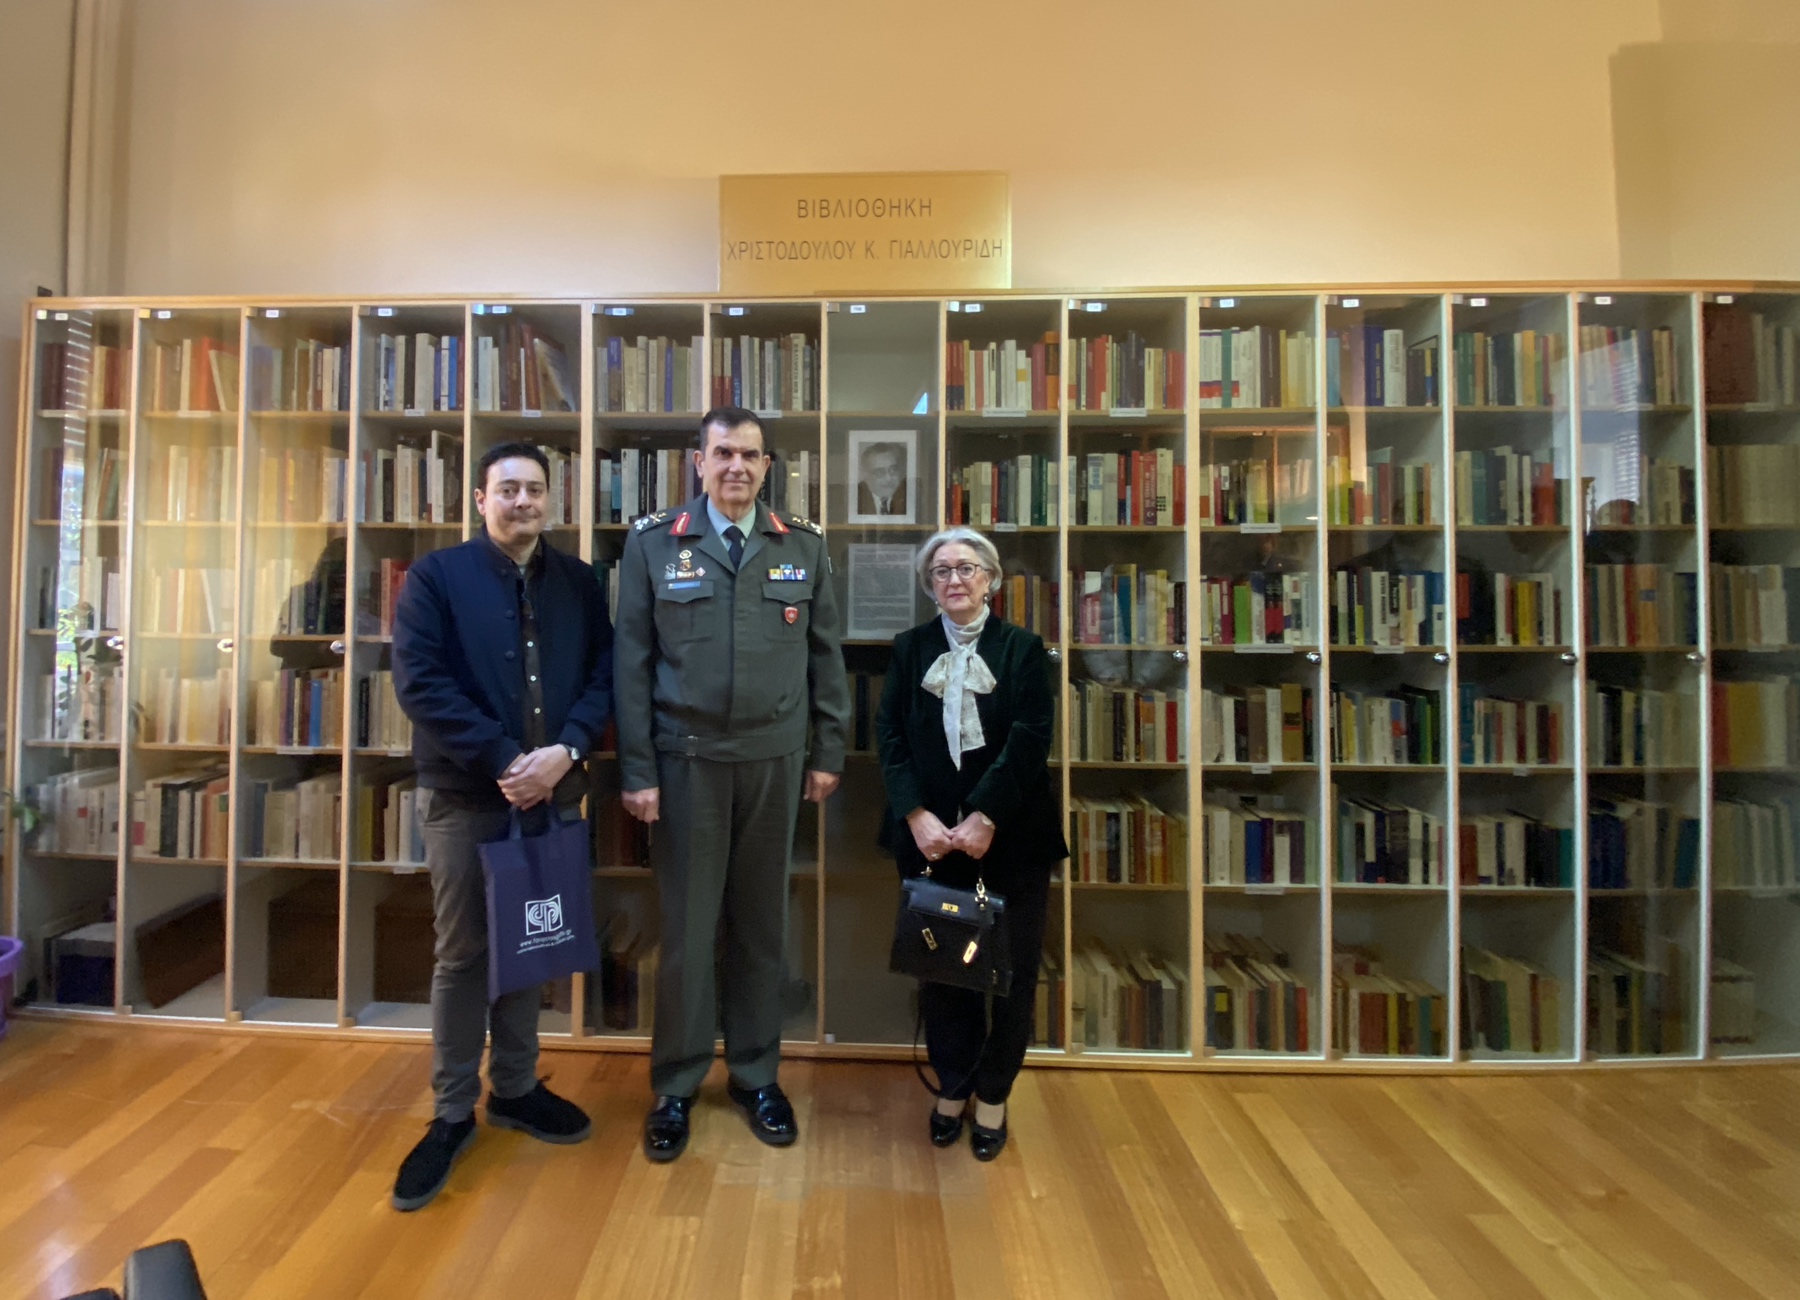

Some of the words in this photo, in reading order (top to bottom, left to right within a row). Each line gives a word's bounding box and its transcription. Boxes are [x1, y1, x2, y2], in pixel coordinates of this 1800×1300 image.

[797, 198, 932, 219] ΒΙΒΛΙΟΘΗΚΗ
[727, 240, 857, 261] ΧΡΙΣΤΟΔΟΥΛΟΥ
[864, 240, 880, 260] Κ.
[889, 239, 1003, 260] ΓΙΑΛΛΟΥΡΙΔΗ
